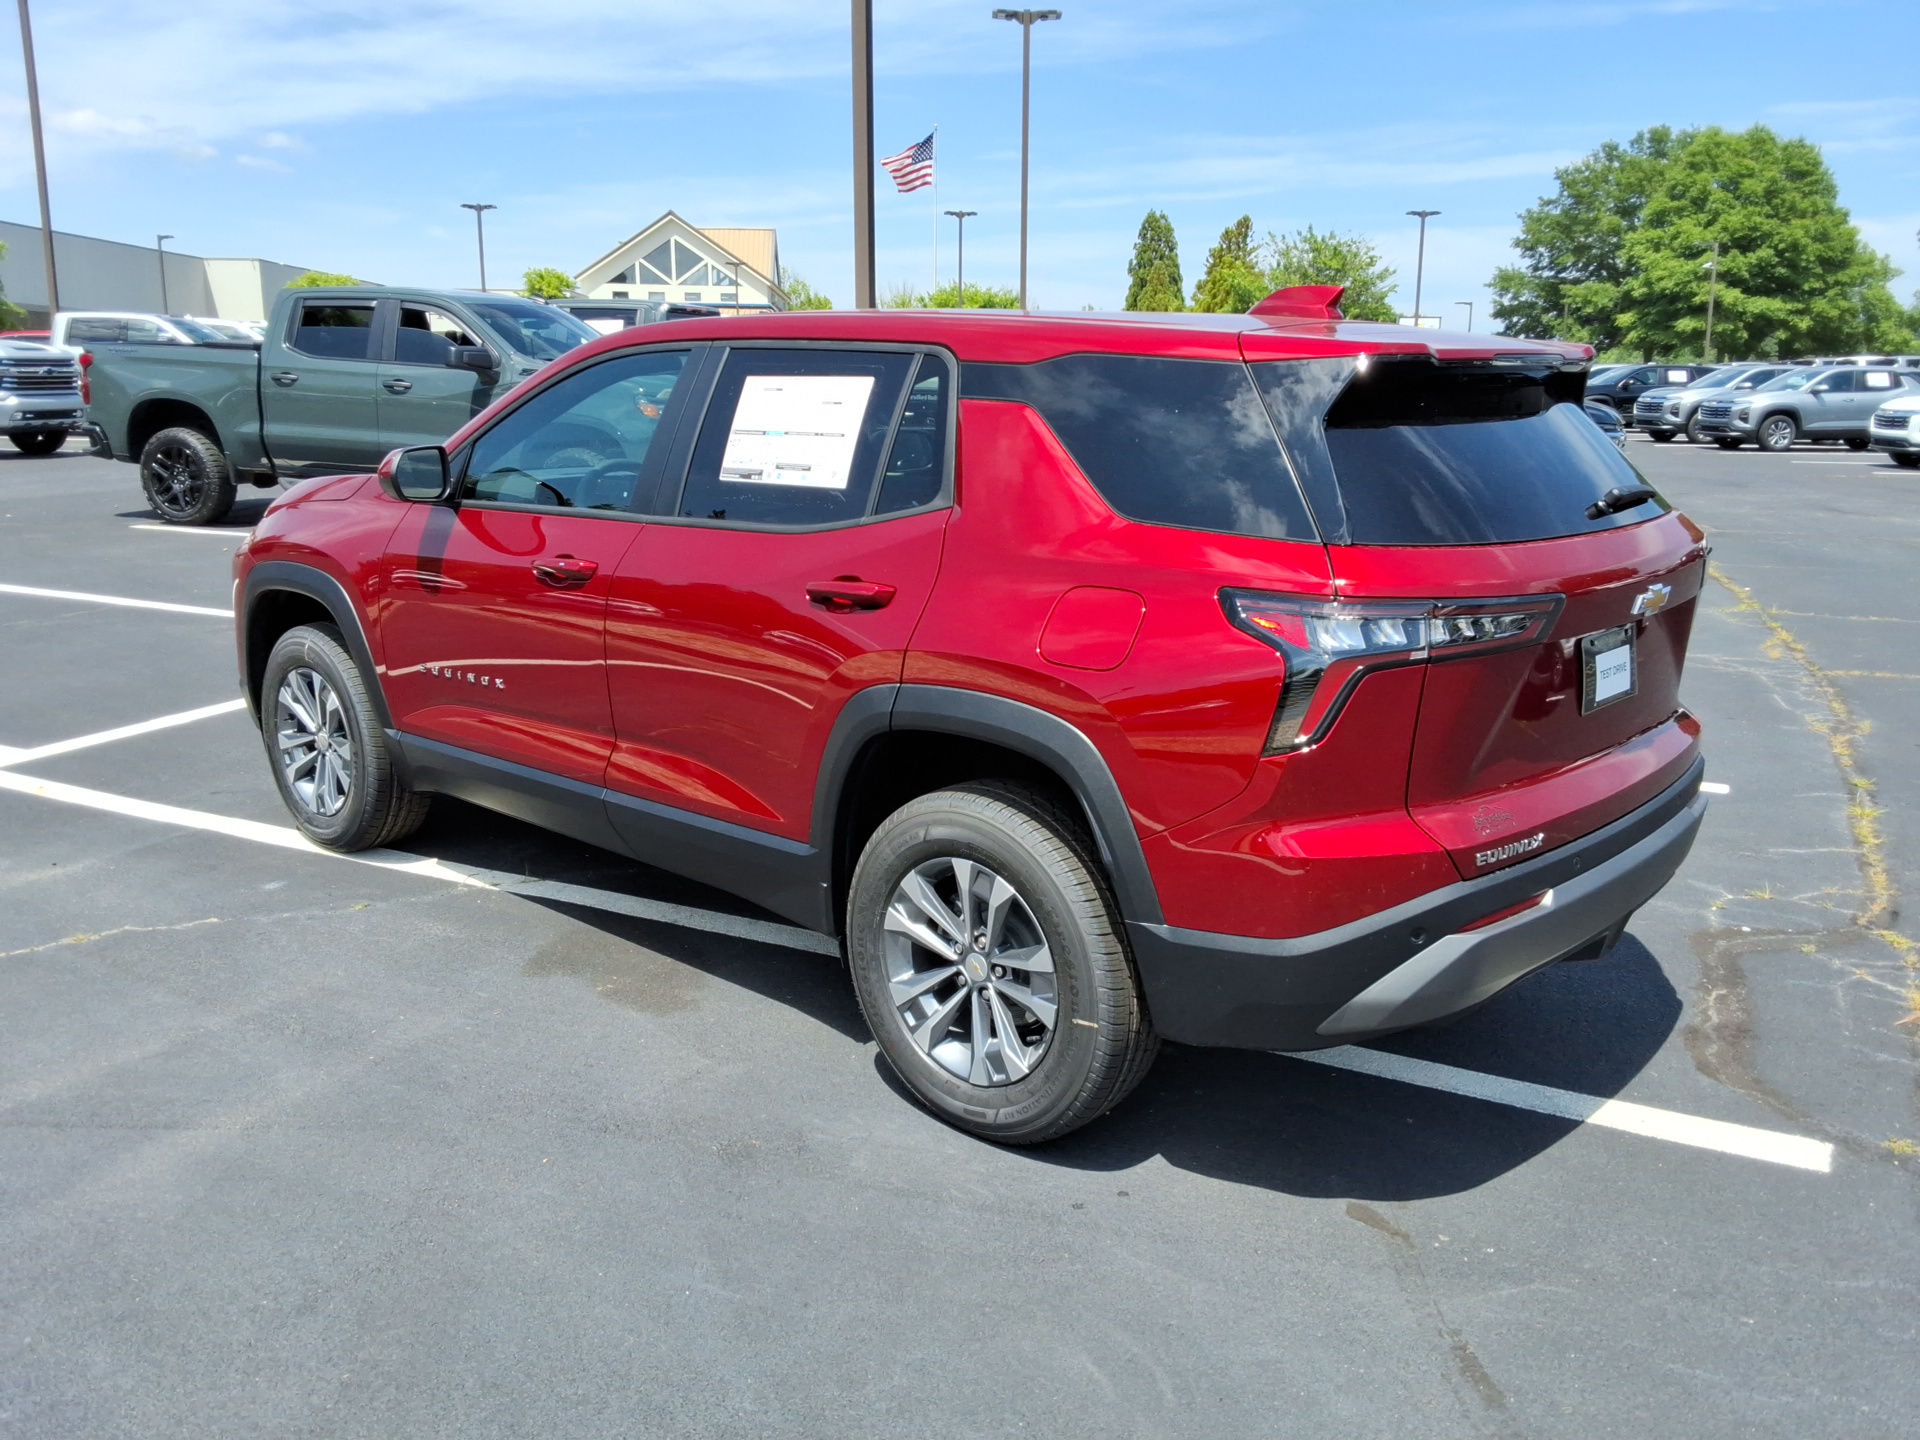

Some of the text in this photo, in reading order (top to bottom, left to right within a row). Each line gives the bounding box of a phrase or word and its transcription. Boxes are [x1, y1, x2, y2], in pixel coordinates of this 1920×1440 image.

[420, 663, 505, 689] EQUINOX
[1600, 661, 1627, 680] TEST DRIVE
[1475, 833, 1544, 866] EQUINOX
